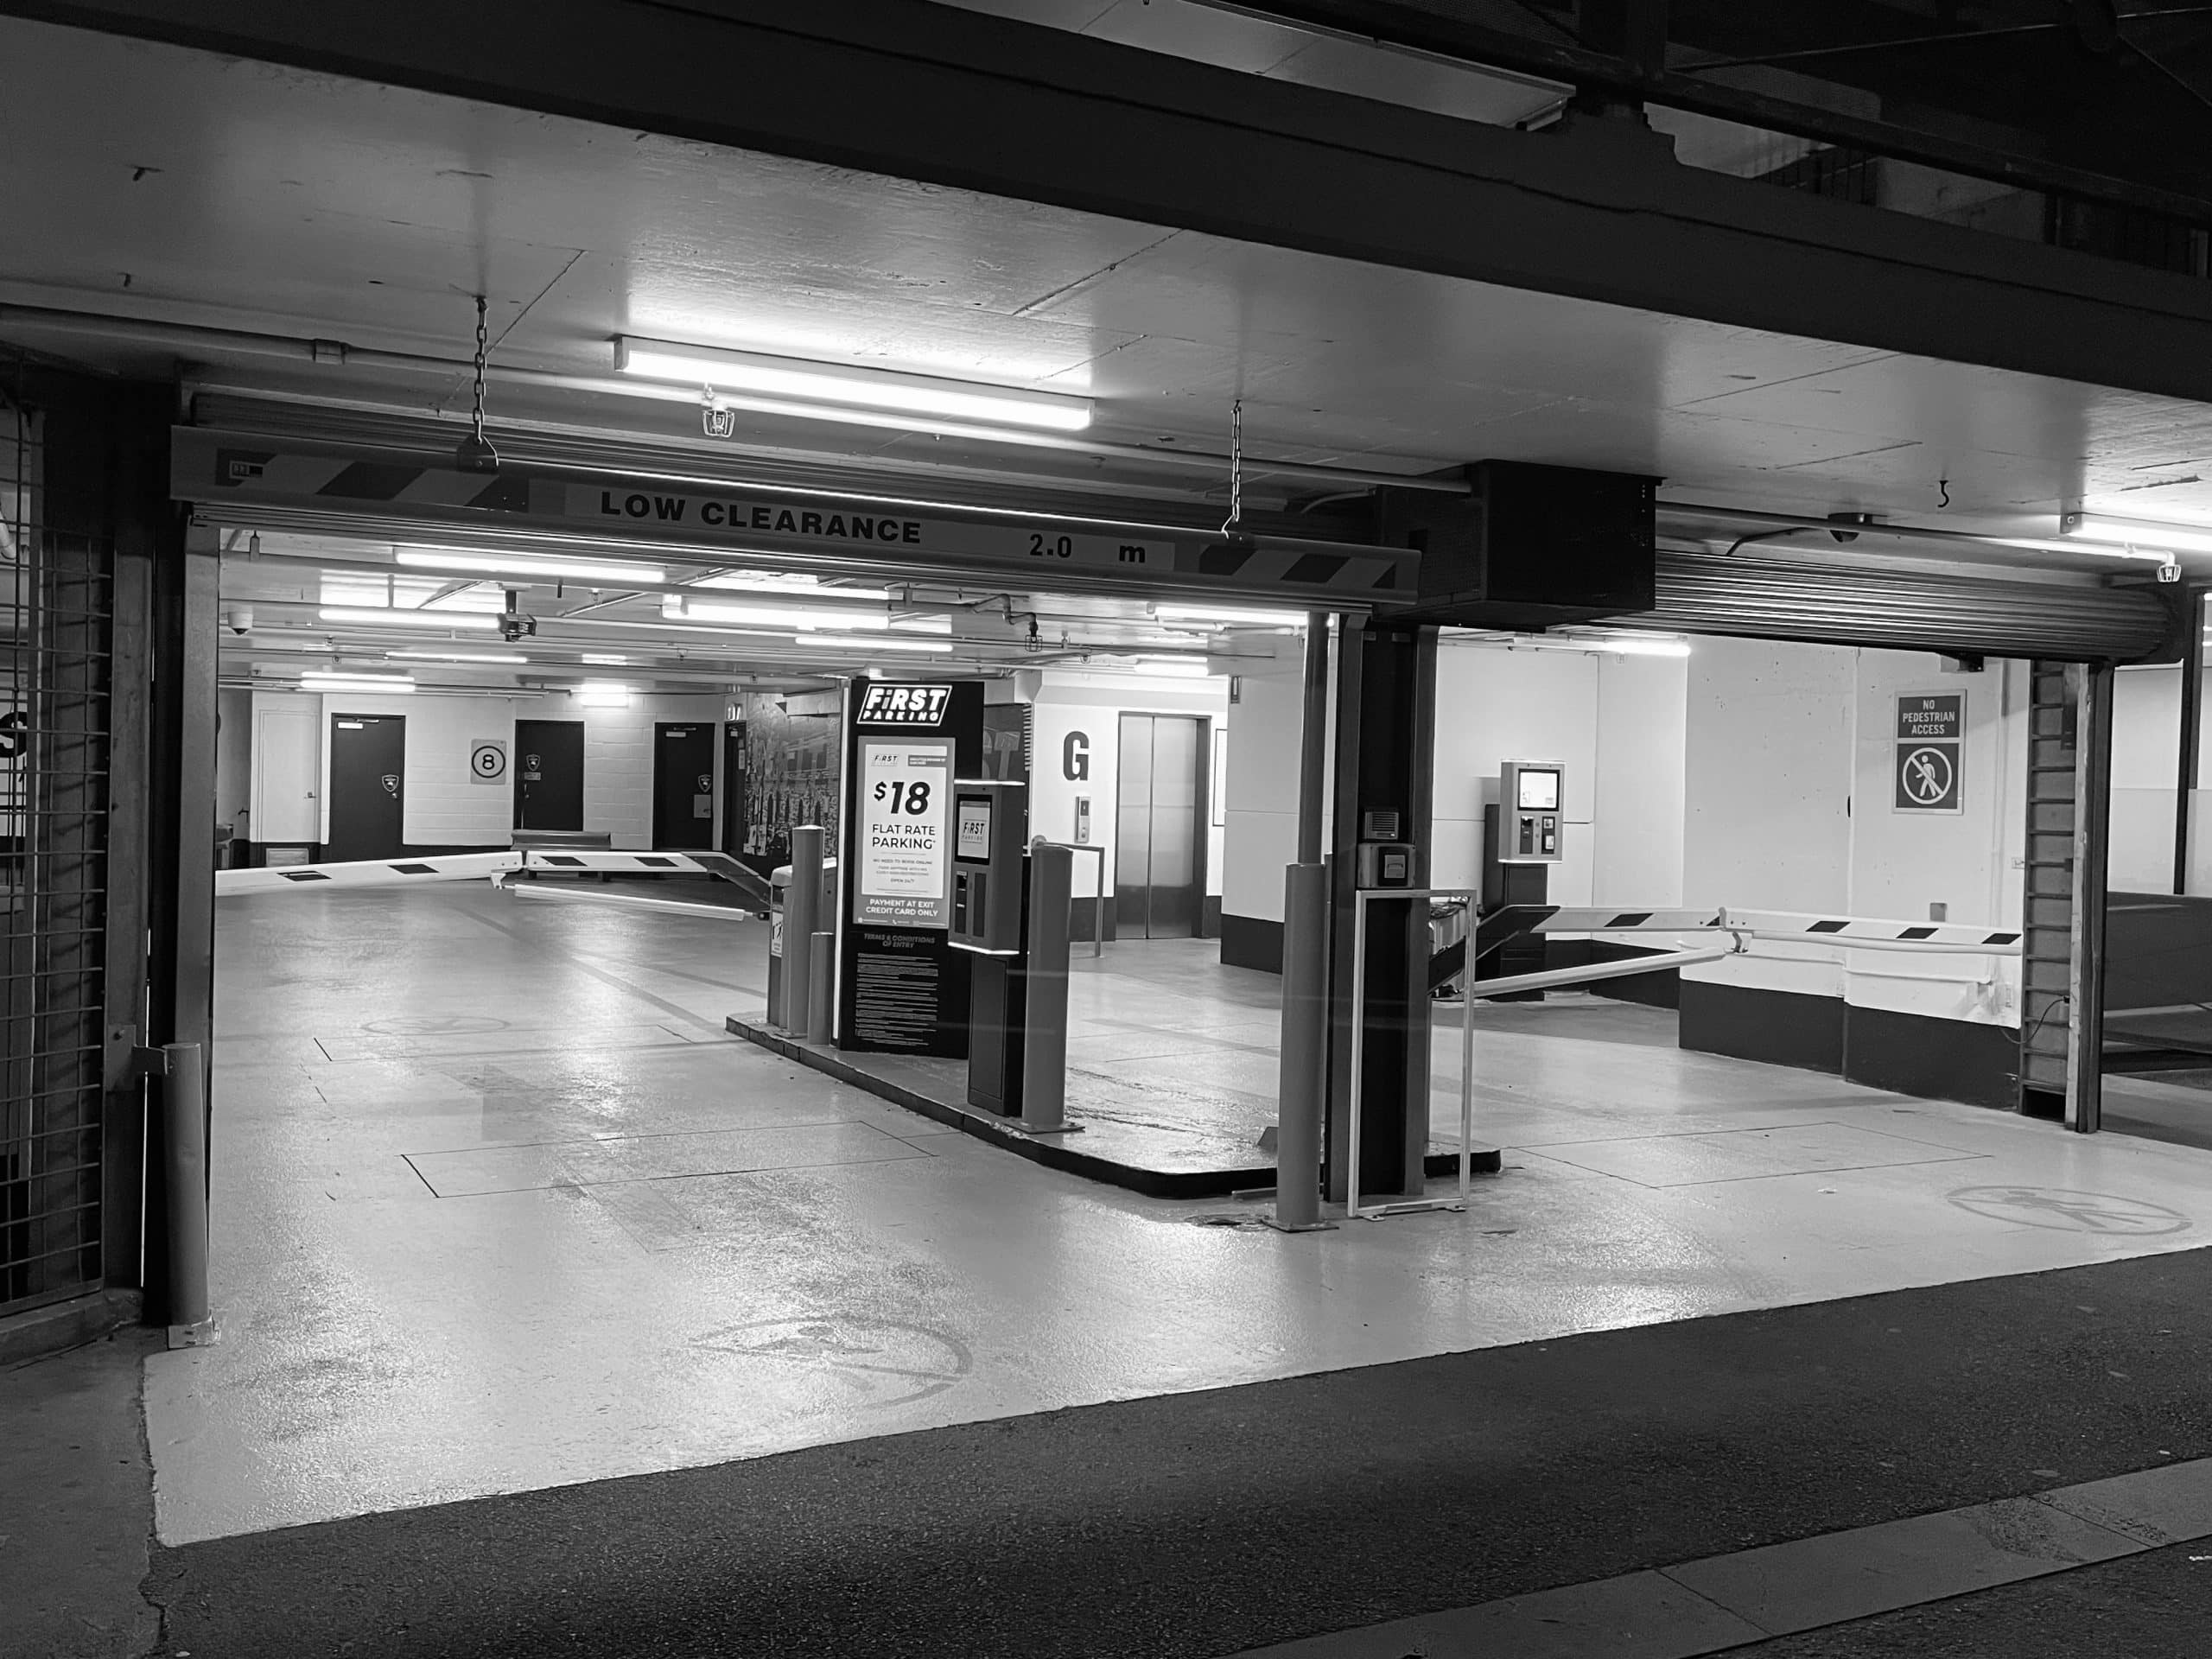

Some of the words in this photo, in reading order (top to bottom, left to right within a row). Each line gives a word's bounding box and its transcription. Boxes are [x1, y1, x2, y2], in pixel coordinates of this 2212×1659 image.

[601, 491, 686, 520] LOW
[701, 501, 921, 543] CLEARANCE
[1029, 534, 1071, 558] 2.0
[1119, 545, 1146, 563] m
[1923, 700, 1936, 709] NO
[863, 710, 938, 721] PARKING
[1903, 712, 1955, 723] PEDESTRIAN
[1911, 724, 1945, 734] ACCESS
[482, 753, 495, 770] 8
[1063, 731, 1090, 781] G
[874, 781, 931, 815] $18
[872, 823, 901, 834] FLAT
[905, 825, 936, 836] RATE
[869, 899, 906, 907] PAYMENT
[892, 935, 935, 944] CONDITIONS
